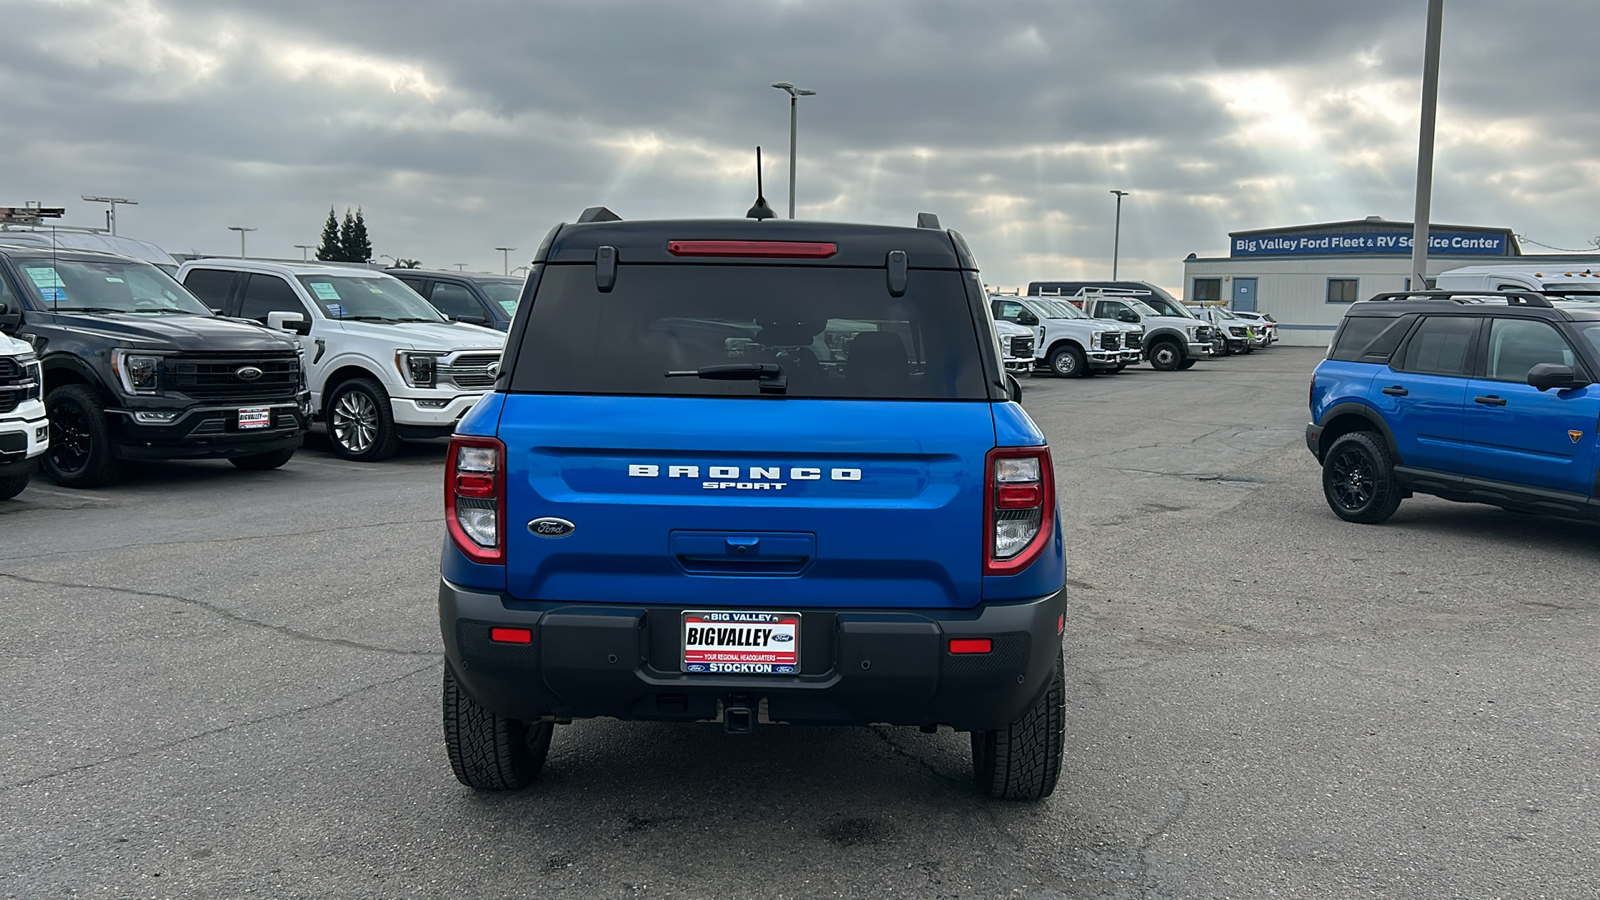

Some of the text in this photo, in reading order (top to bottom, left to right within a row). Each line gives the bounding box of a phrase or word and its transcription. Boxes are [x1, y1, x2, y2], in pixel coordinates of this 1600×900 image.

[1236, 236, 1500, 252] Big Valley Ford Fleet & RV Seice Center
[628, 464, 862, 481] BRONCO
[702, 481, 787, 490] SPORT
[537, 521, 565, 533] Ford
[711, 613, 772, 622] BIG VALLEY
[687, 627, 772, 647] BIGVALLEY
[740, 654, 776, 662] HEADQUARTERS
[709, 663, 772, 673] STOCKTON
